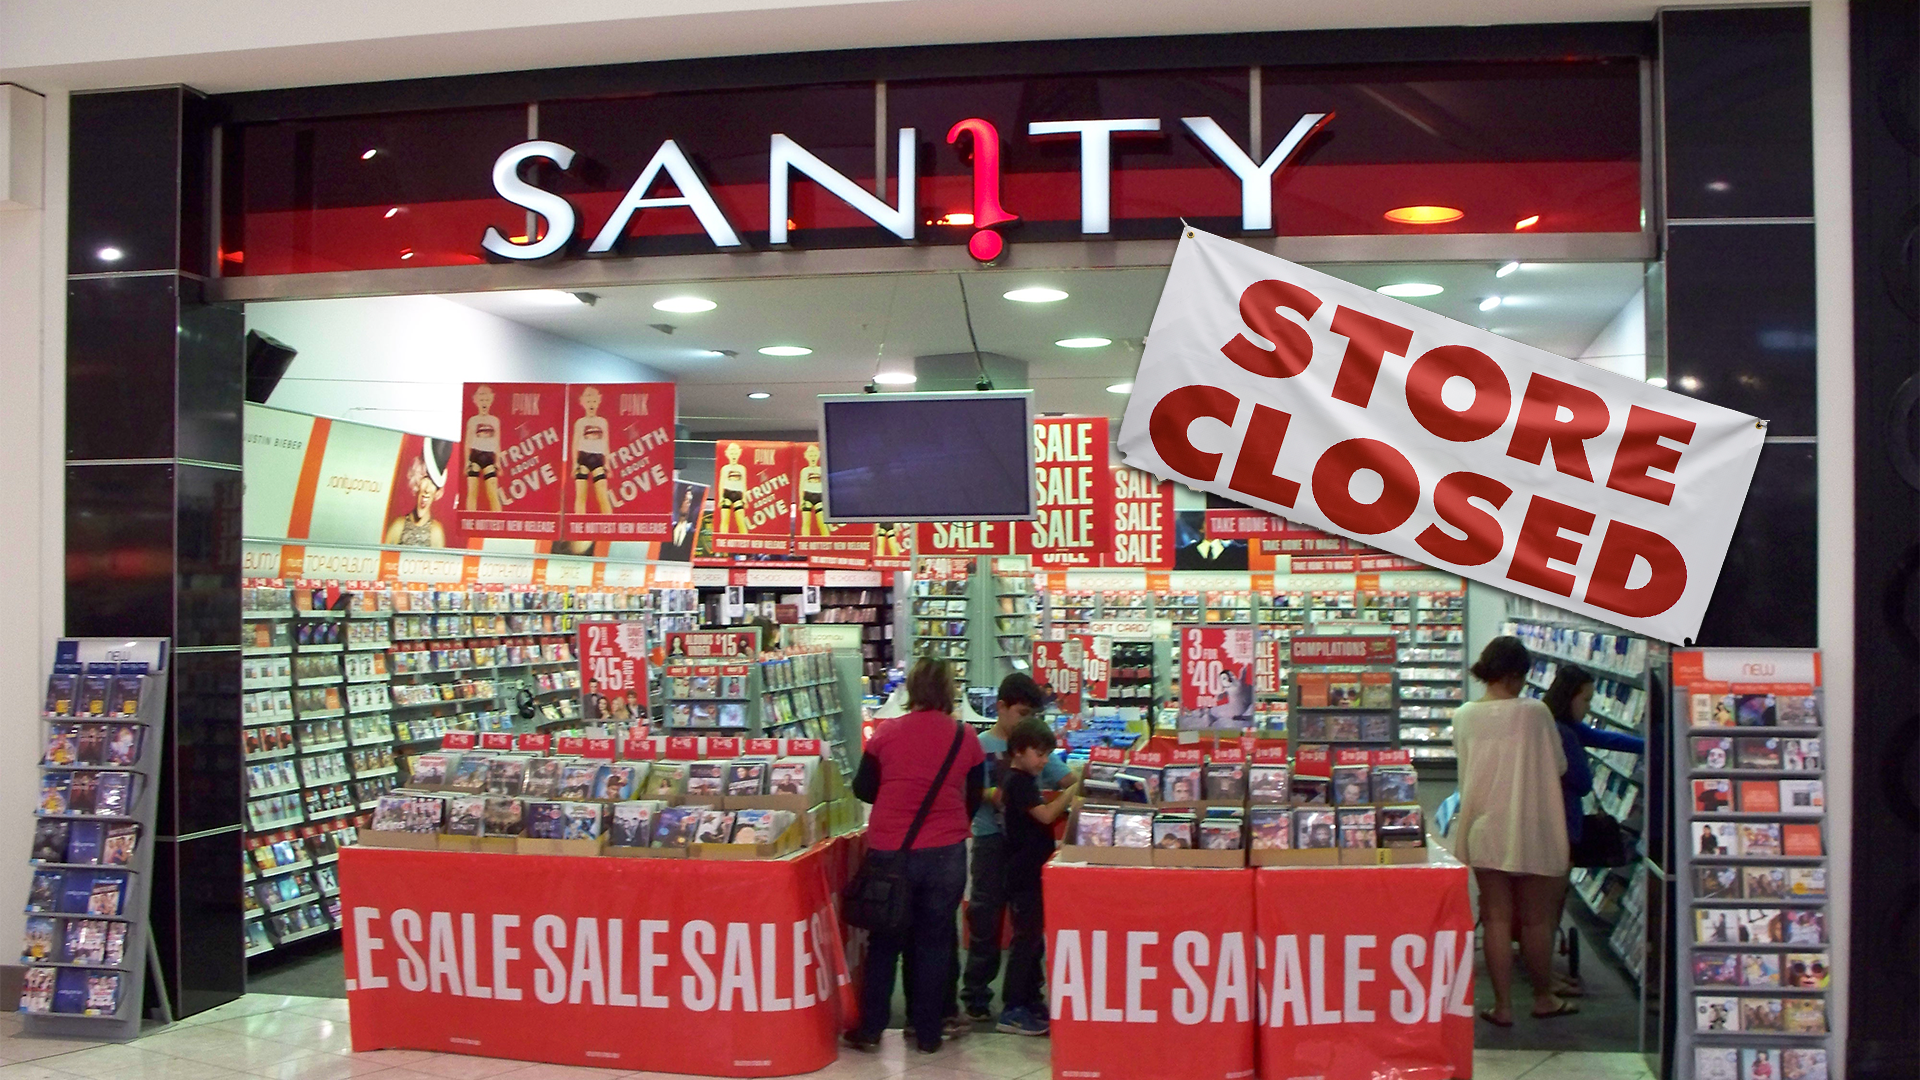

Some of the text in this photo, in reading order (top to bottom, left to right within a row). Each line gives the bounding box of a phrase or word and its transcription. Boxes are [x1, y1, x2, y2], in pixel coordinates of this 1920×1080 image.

[1220, 278, 1697, 506] STORE
[500, 427, 559, 467] TRUTH
[609, 427, 670, 469] TRUTH
[1033, 423, 1093, 463] SALE
[497, 463, 558, 506] LOVE
[608, 464, 669, 508] LOVE
[745, 473, 790, 502] TRUTH
[1035, 466, 1094, 506] SALE
[1115, 470, 1163, 499] SALE
[1149, 384, 1688, 618] CLOSED
[744, 499, 788, 530] LOVE
[1031, 509, 1094, 549] SALE
[1114, 502, 1163, 531] SALE
[1211, 517, 1236, 532] TAKE
[1238, 517, 1267, 532] HOME
[1114, 533, 1163, 563] SALE
[587, 626, 601, 656] 2
[1091, 623, 1151, 633] GIFT CARDS
[1188, 628, 1202, 660] 3
[1037, 645, 1047, 668] 3
[1294, 641, 1367, 656] COMPILATIONS
[588, 657, 622, 690] $45
[1045, 668, 1070, 694] $40
[1187, 660, 1223, 695] $40
[391, 907, 522, 1001] SALE
[533, 914, 670, 1008] SALE
[682, 919, 816, 1012] SALE
[1050, 929, 1250, 1025] ALE SA
[1390, 930, 1474, 1024] SAL
